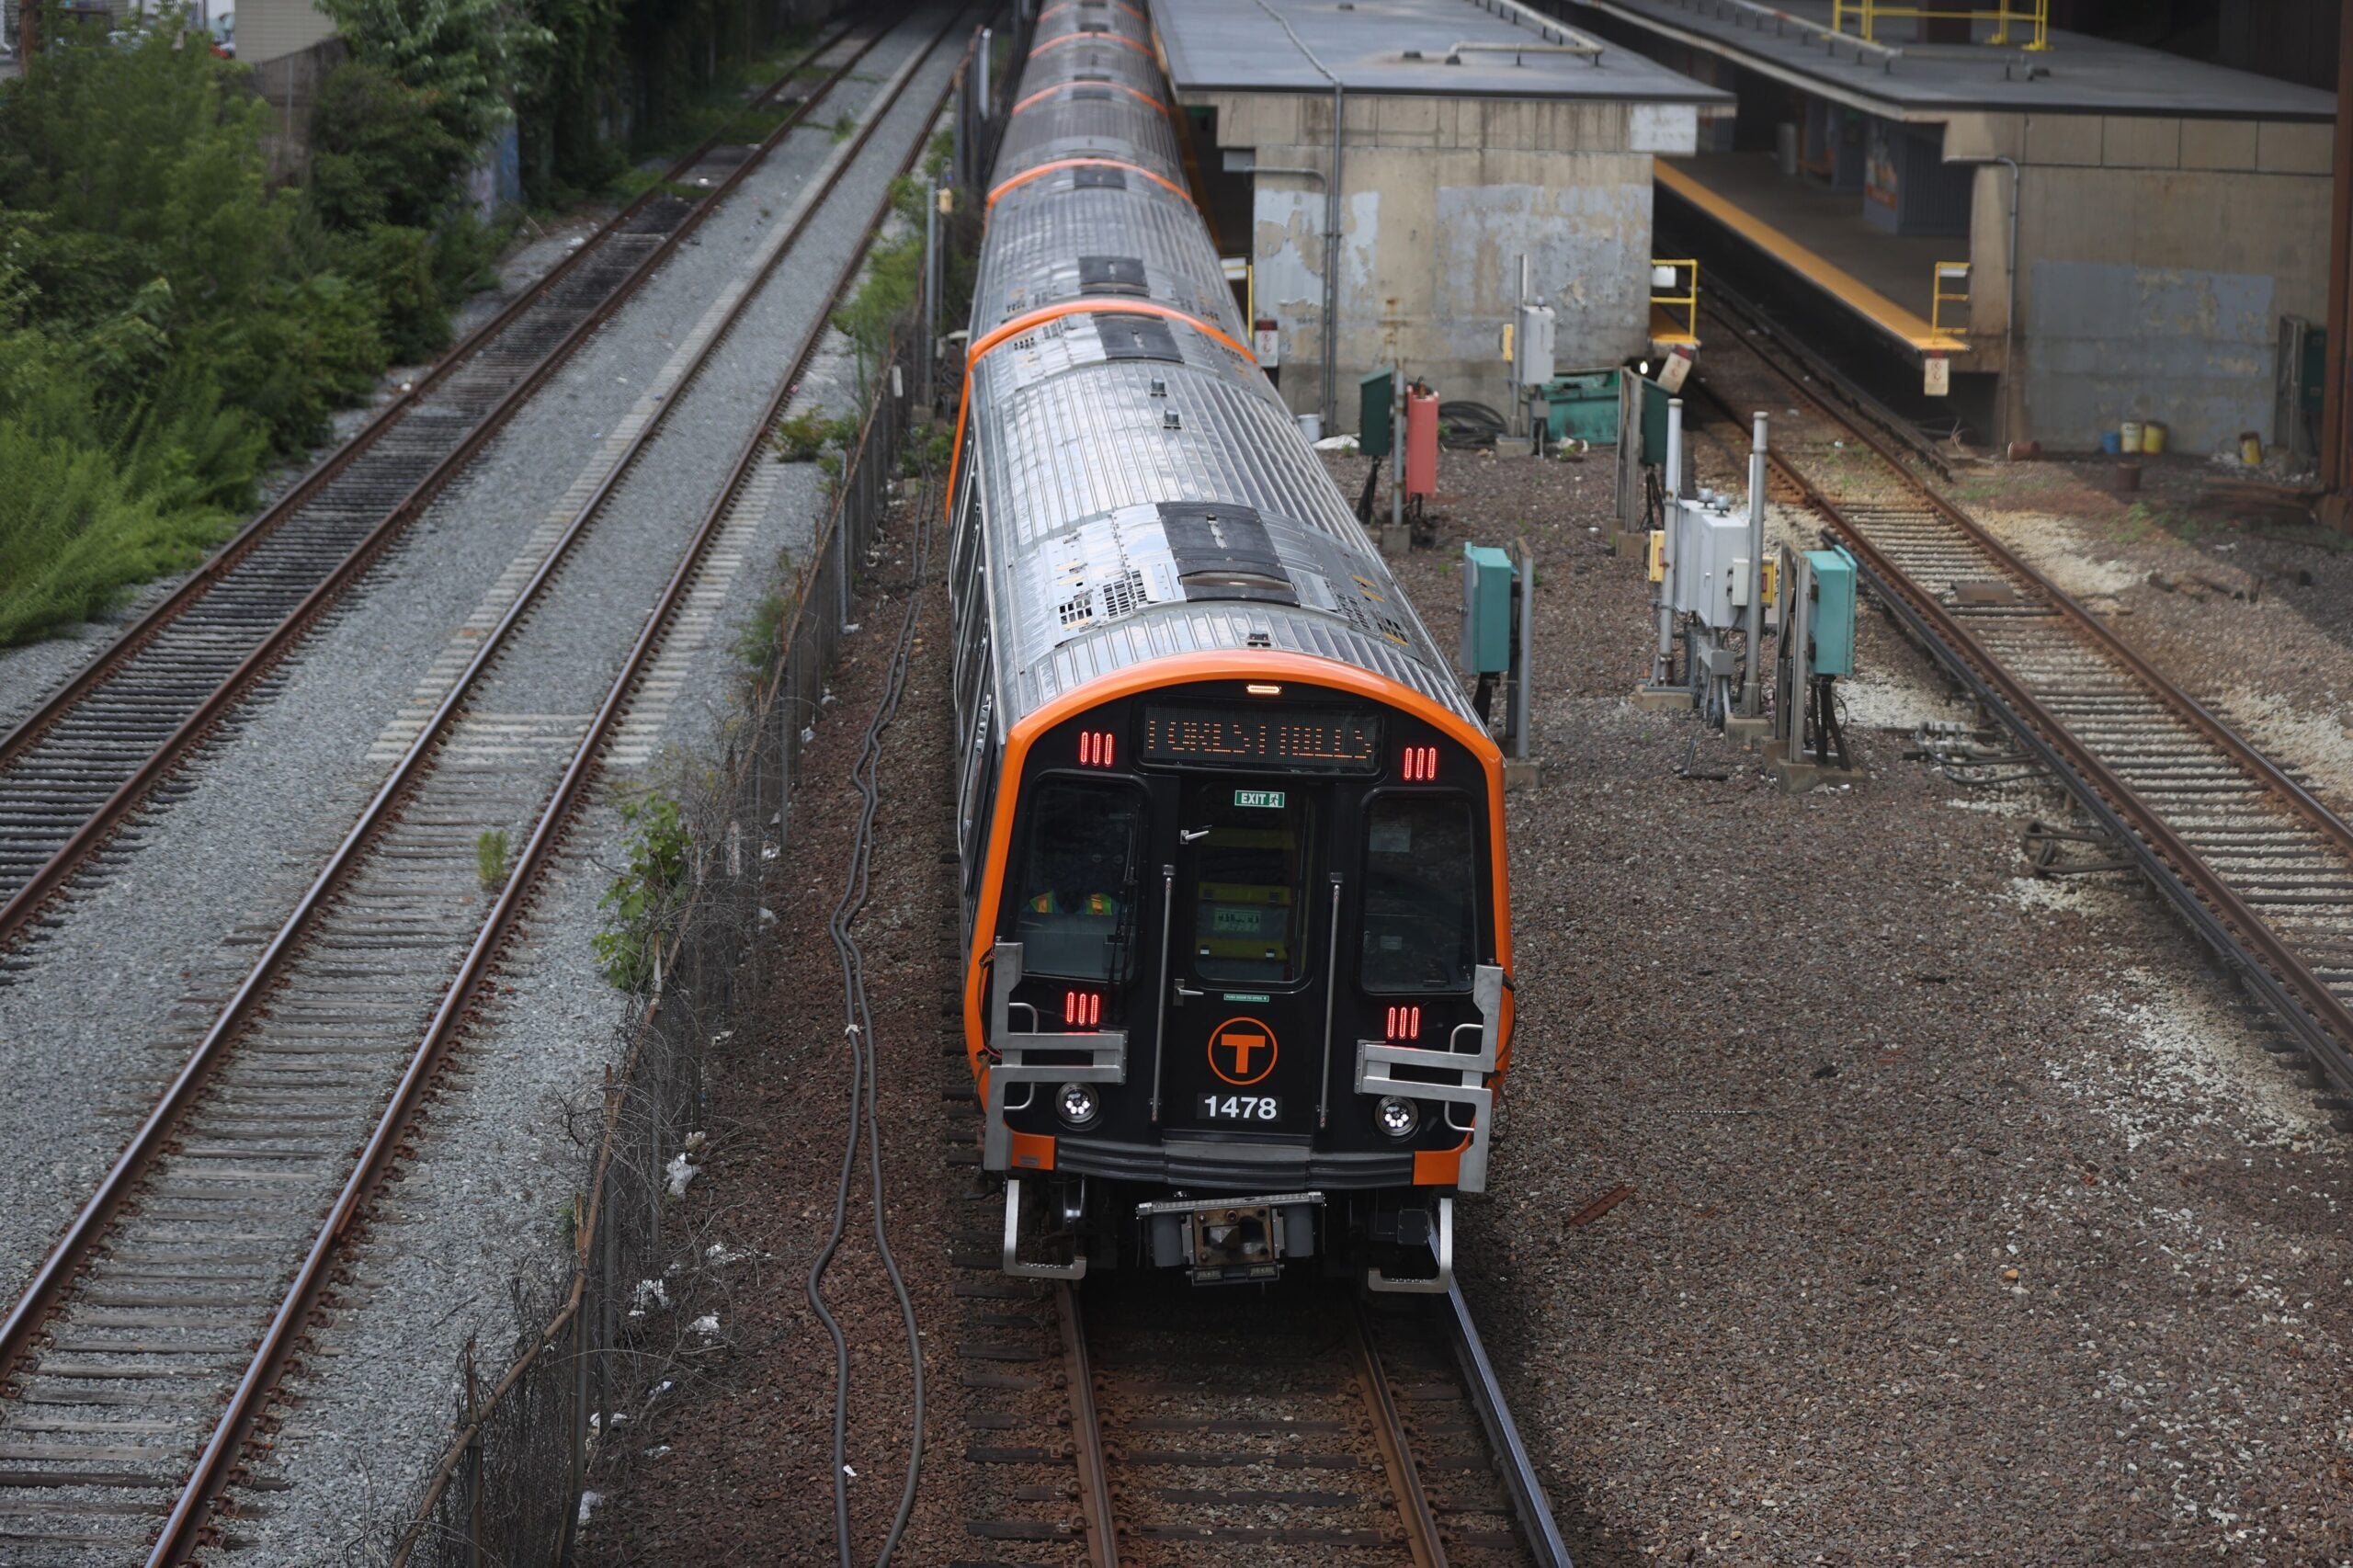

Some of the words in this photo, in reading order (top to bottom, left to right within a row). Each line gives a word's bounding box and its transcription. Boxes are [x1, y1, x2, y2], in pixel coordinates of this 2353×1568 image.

[1240, 792, 1267, 806] EXIT
[1221, 1033, 1266, 1074] T
[1204, 1095, 1278, 1120] 1478
